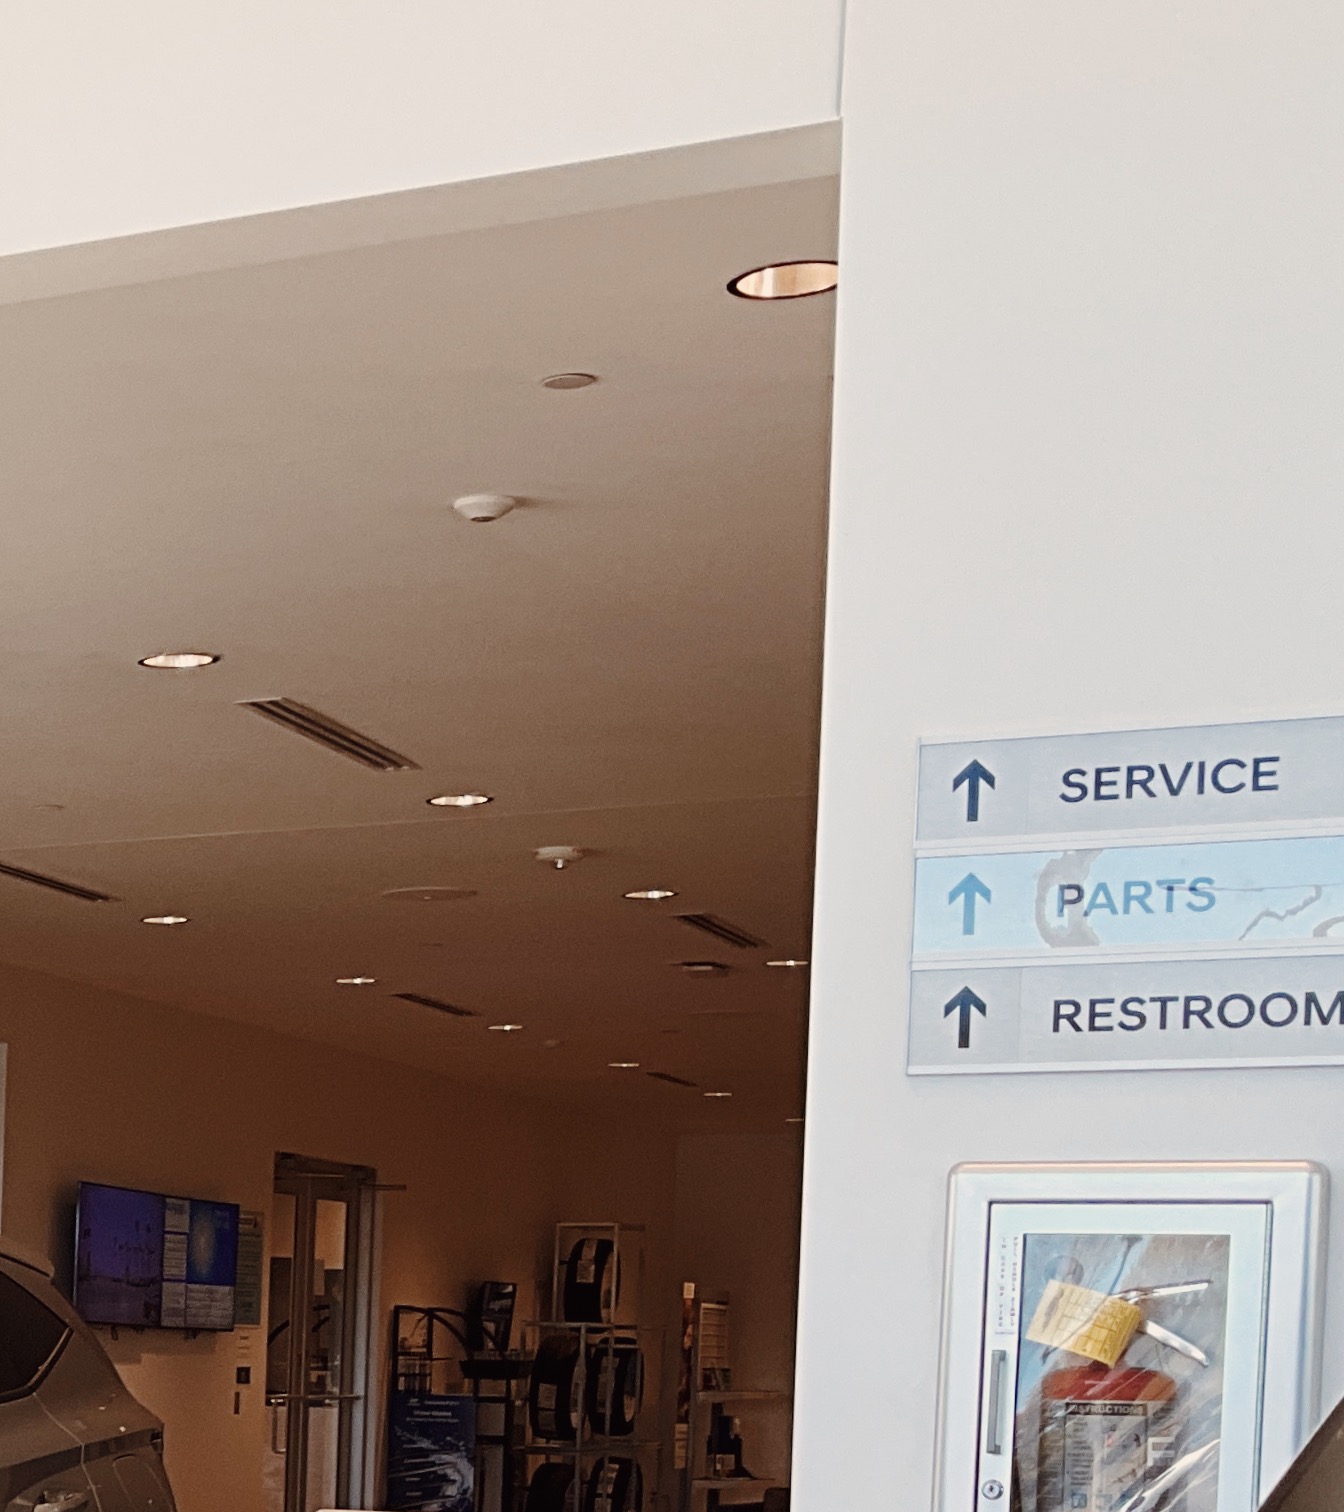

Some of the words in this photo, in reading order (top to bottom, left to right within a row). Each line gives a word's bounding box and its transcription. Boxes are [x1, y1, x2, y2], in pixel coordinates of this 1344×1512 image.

[1059, 756, 1281, 803] SERVICE
[1057, 876, 1216, 918] PARTS
[1052, 991, 1344, 1034] RESTROOM
